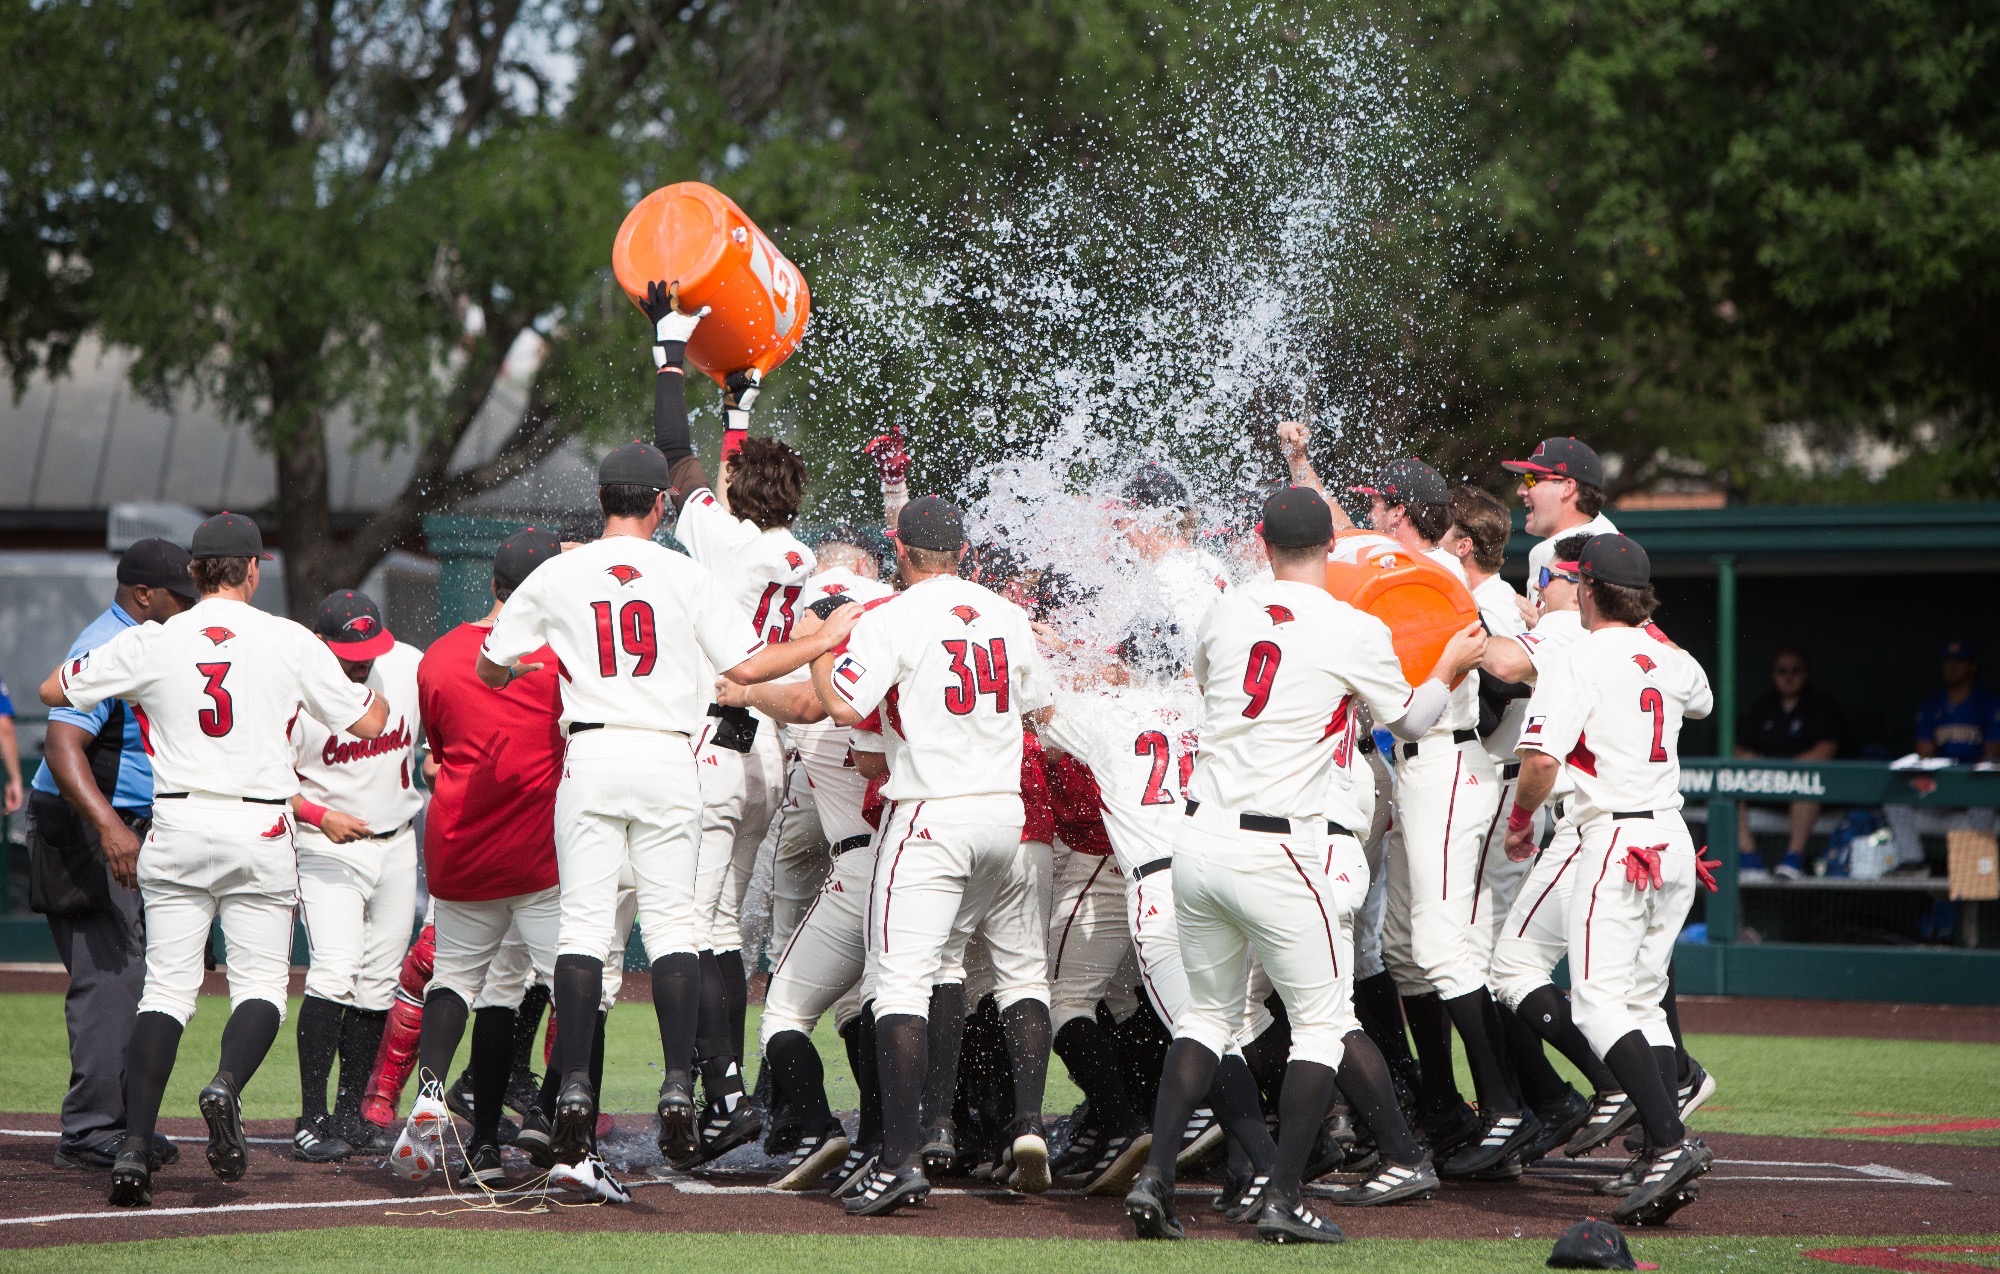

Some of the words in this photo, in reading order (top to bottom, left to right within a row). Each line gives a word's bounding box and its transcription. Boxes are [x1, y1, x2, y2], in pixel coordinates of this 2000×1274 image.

[590, 600, 658, 678] 19
[752, 581, 803, 644] 13
[196, 661, 234, 738] 3
[941, 637, 1009, 715] 34
[1242, 640, 1282, 720] 9
[322, 715, 412, 766] Cardinals
[1640, 687, 1668, 762] 2
[1716, 768, 1826, 795] BASEBALL
